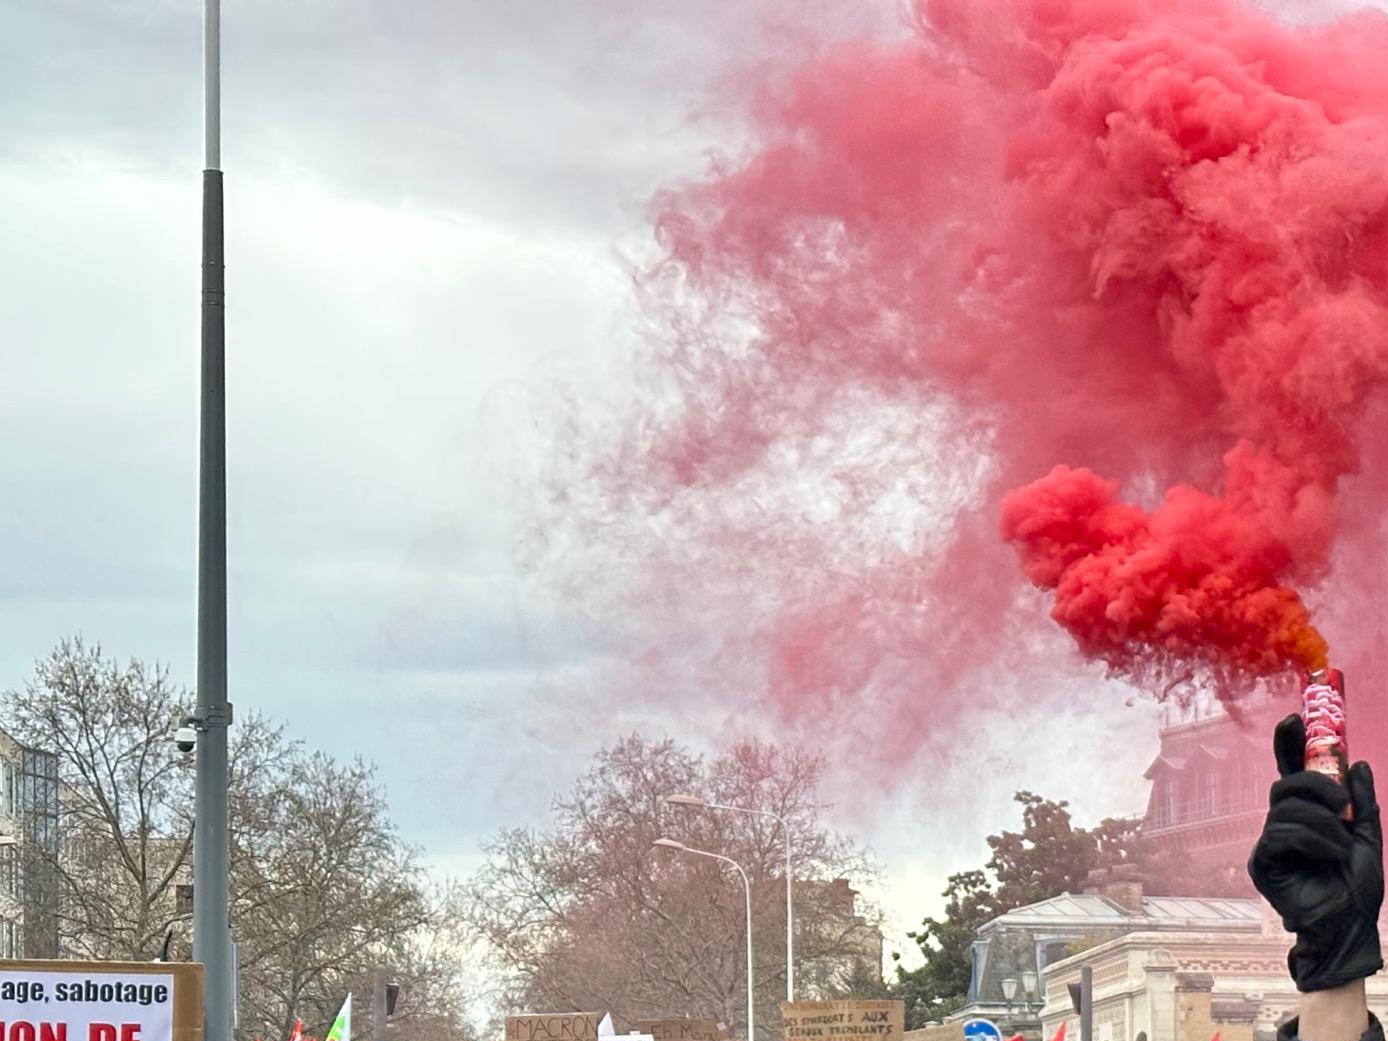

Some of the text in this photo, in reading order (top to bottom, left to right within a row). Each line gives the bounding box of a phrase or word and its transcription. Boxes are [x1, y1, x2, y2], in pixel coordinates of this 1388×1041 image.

[55, 980, 168, 1006] sabotage
[862, 1011, 889, 1022] AUX
[516, 1016, 598, 1040] MACRON
[651, 1024, 672, 1040] Eh
